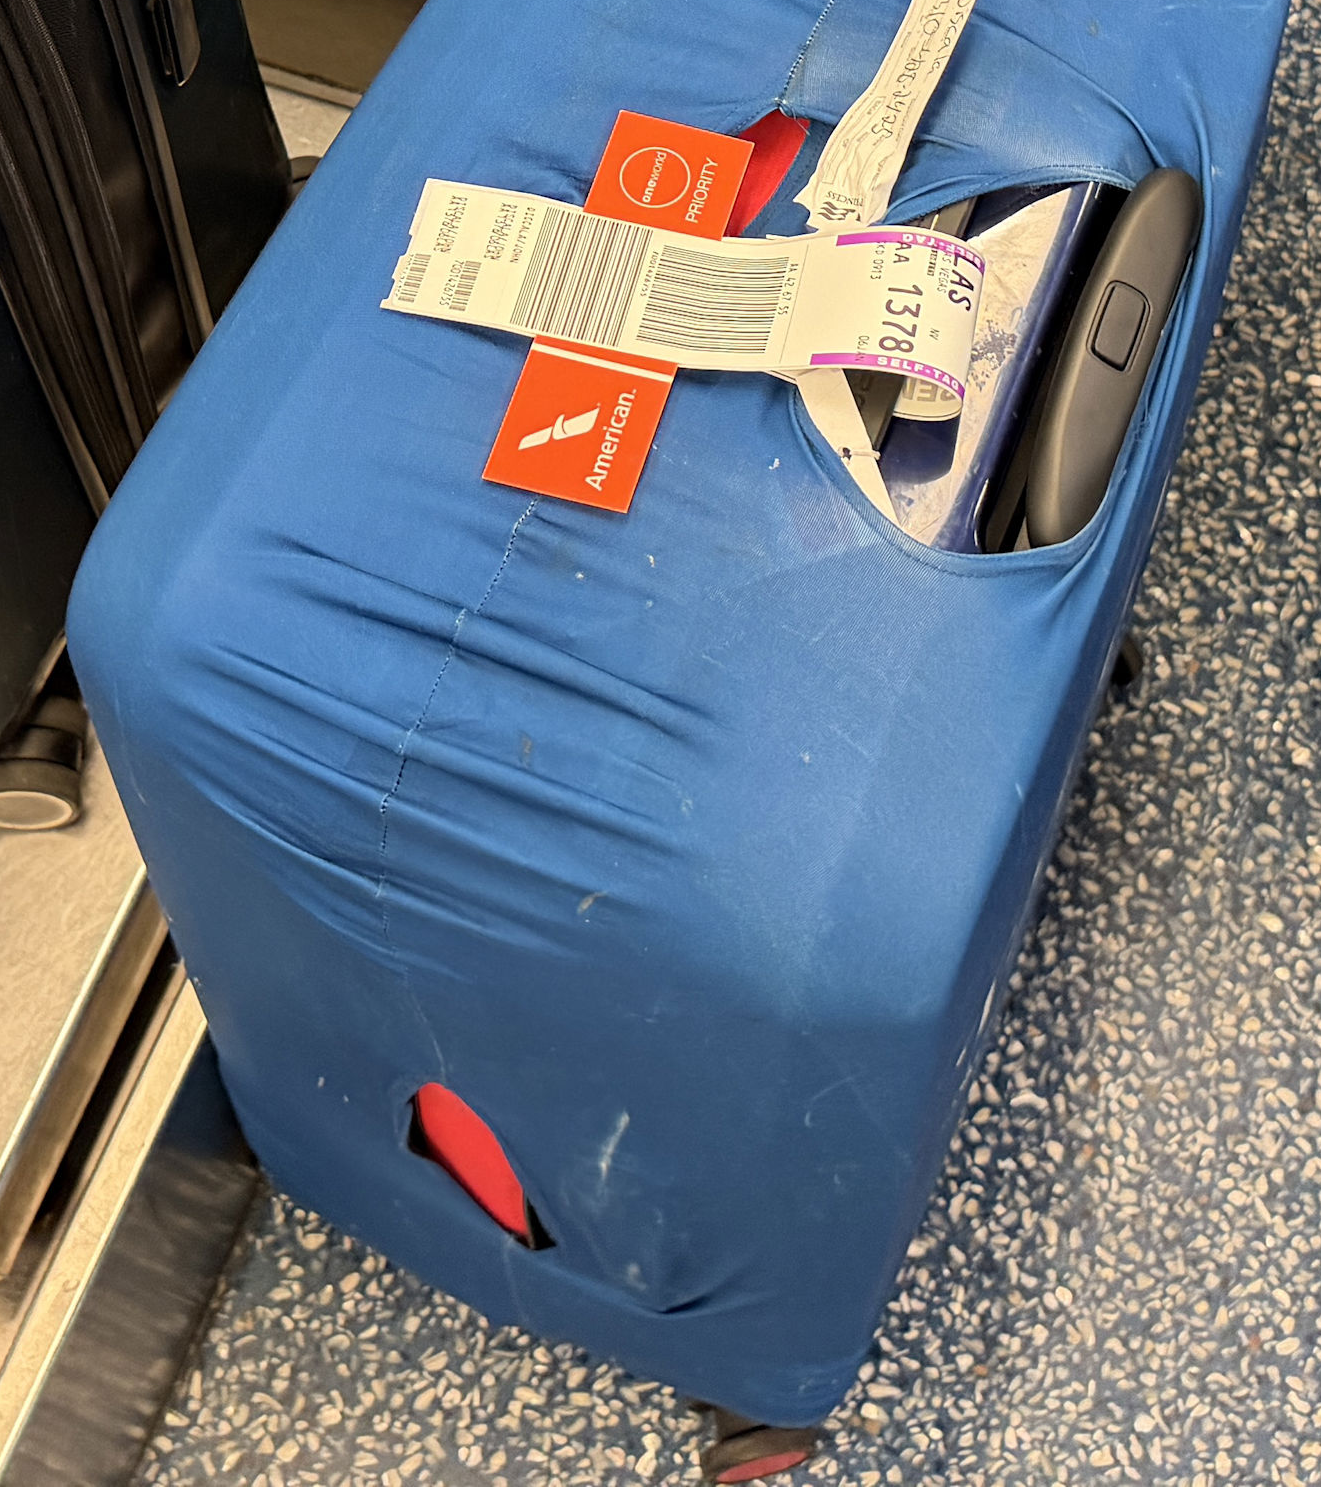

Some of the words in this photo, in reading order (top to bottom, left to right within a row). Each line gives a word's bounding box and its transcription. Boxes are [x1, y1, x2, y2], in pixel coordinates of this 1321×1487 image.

[641, 150, 668, 203] oneworld
[684, 156, 720, 224] PRIORITY
[870, 259, 885, 281] 0913
[892, 241, 913, 264] AA
[783, 276, 795, 288] 42
[936, 267, 951, 294] VEGAS
[947, 253, 986, 312] LAS
[878, 284, 924, 353] 1378
[876, 356, 960, 390] SELF-TAG
[584, 392, 636, 492] American
